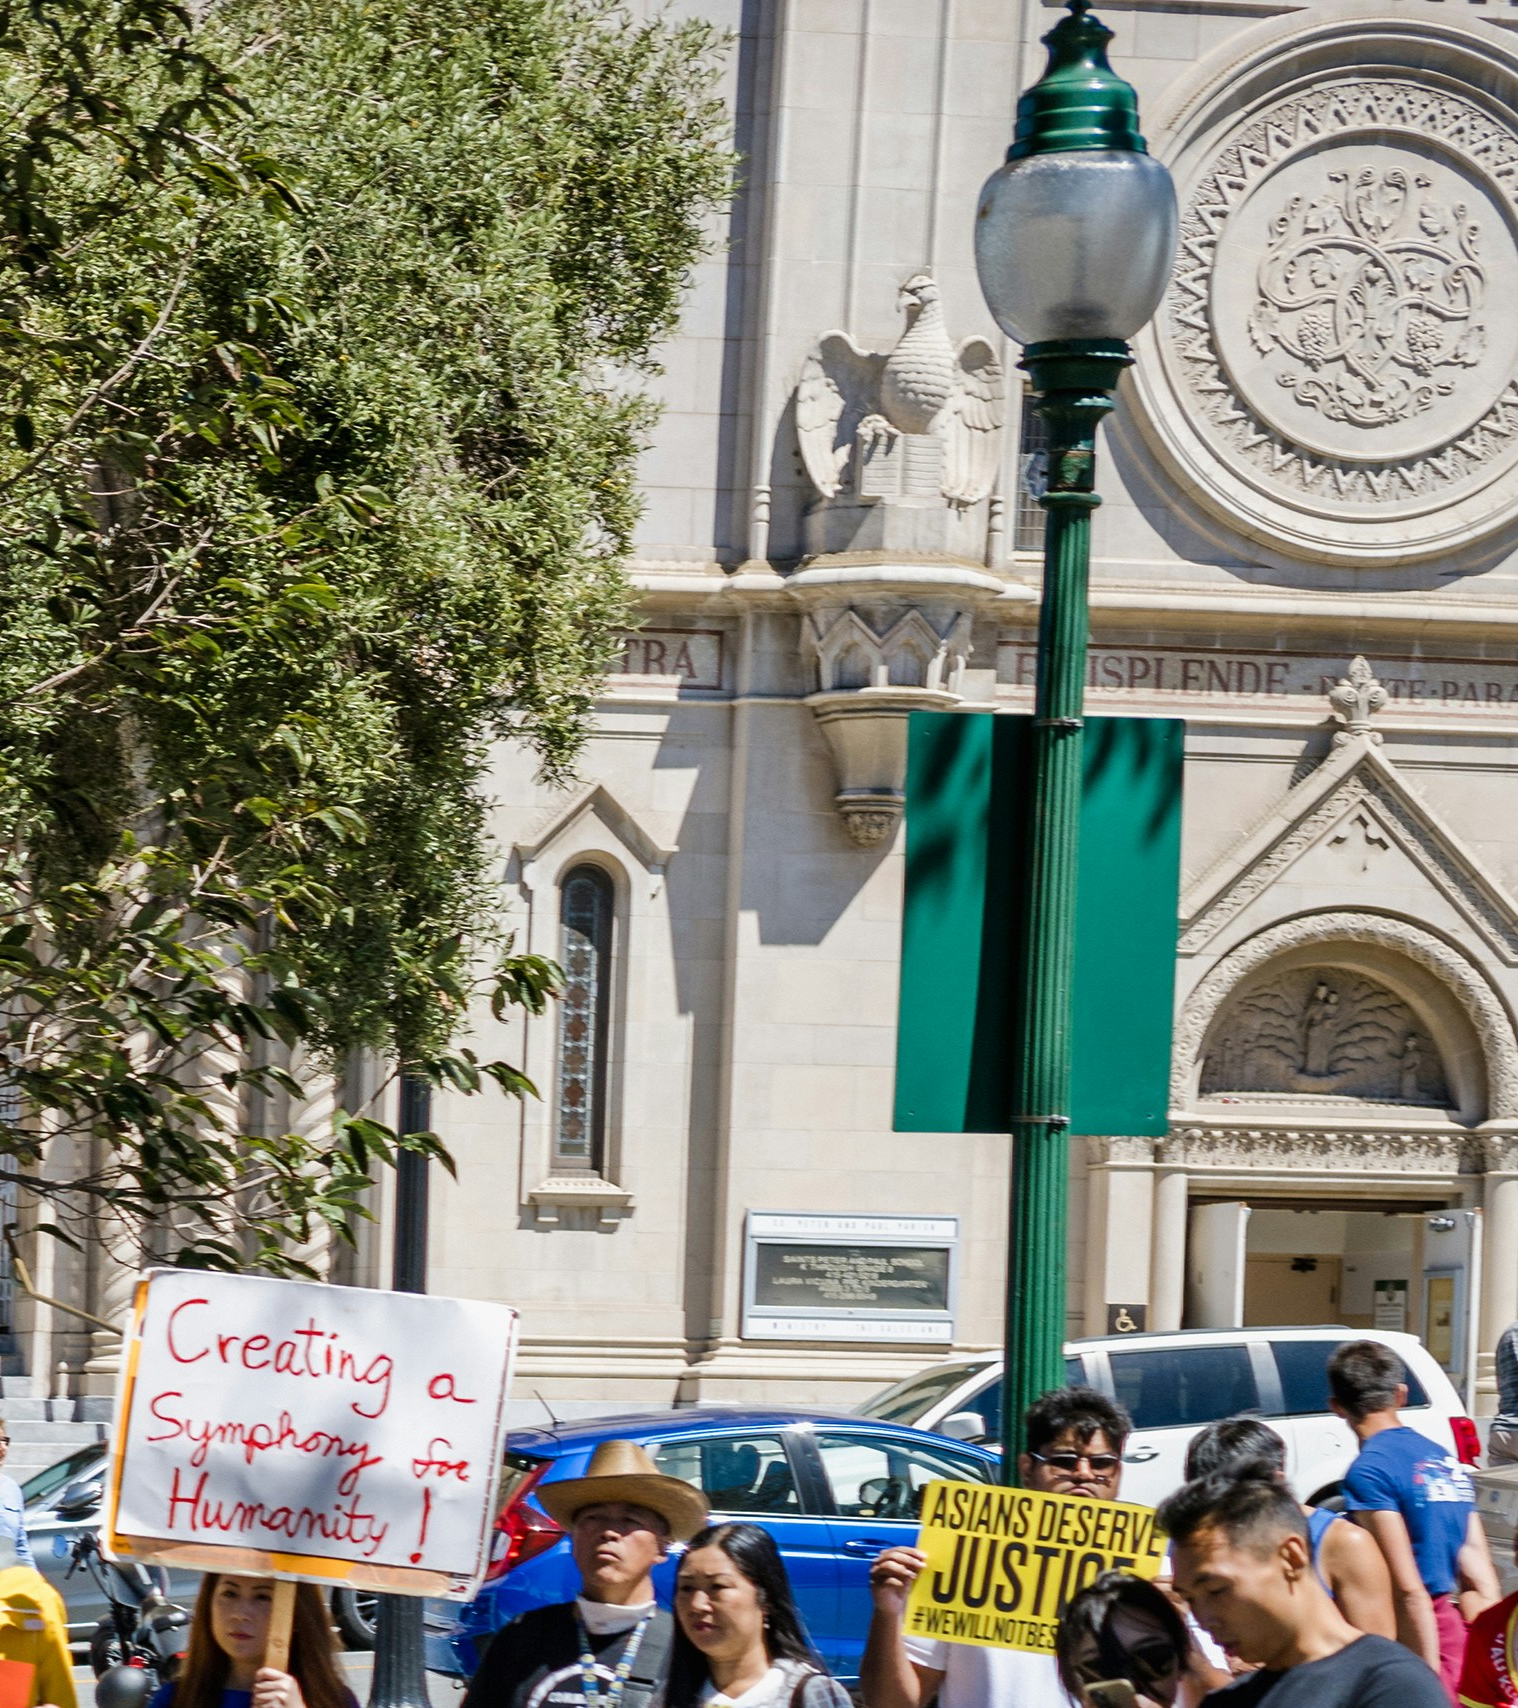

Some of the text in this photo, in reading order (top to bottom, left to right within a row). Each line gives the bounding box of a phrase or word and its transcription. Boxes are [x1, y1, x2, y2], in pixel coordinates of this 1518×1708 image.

[167, 1299, 478, 1418] Creating a
[147, 1391, 471, 1497] Symphony for
[167, 1467, 389, 1557] Humanity
[929, 1486, 1162, 1558] ASIANS DESERVE
[931, 1535, 1138, 1617] JUSTIC
[911, 1605, 1059, 1649] #WEWILLNOTBES
